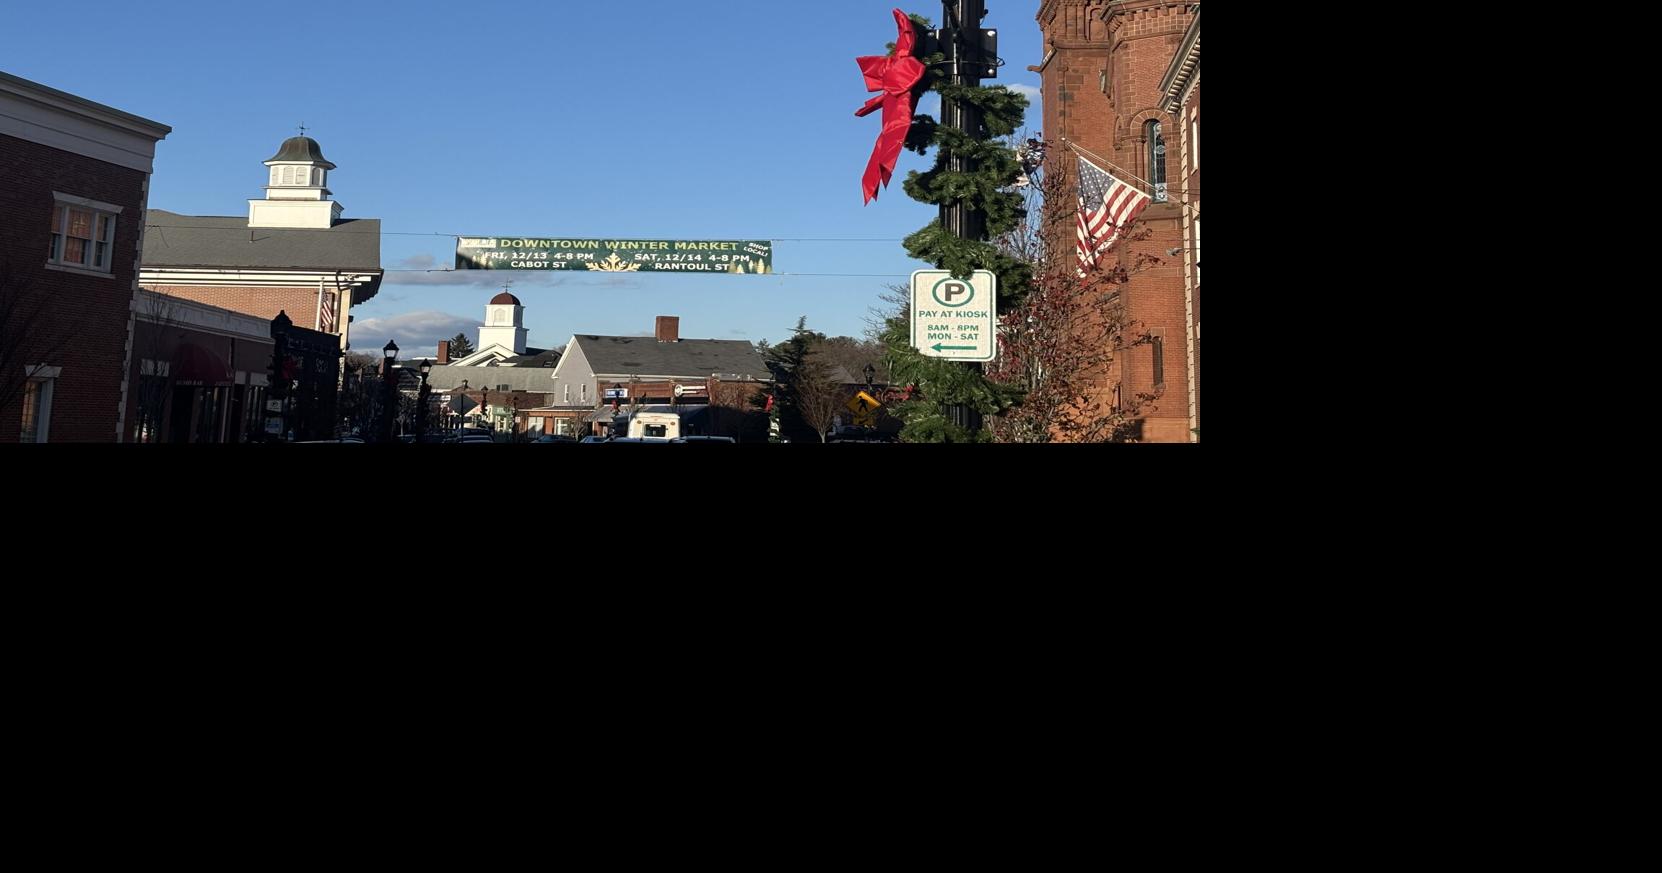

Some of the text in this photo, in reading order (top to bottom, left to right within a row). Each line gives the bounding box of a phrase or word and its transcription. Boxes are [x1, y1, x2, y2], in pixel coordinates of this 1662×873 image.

[501, 240, 599, 249] DOWNTOWN
[605, 241, 669, 250] WINTER
[675, 242, 738, 251] MARKET
[749, 242, 769, 250] SHOP
[484, 251, 508, 260] FRI,
[512, 252, 547, 260] 12/13
[554, 252, 574, 260] 4-8
[744, 246, 769, 257] LOCAL!
[634, 253, 750, 262] SAT, 12/14 4-8 PM
[655, 263, 729, 271] RANTOUL ST
[944, 283, 965, 301] P
[918, 310, 988, 318] PAY AT KIOSK
[960, 333, 979, 341] SAT
